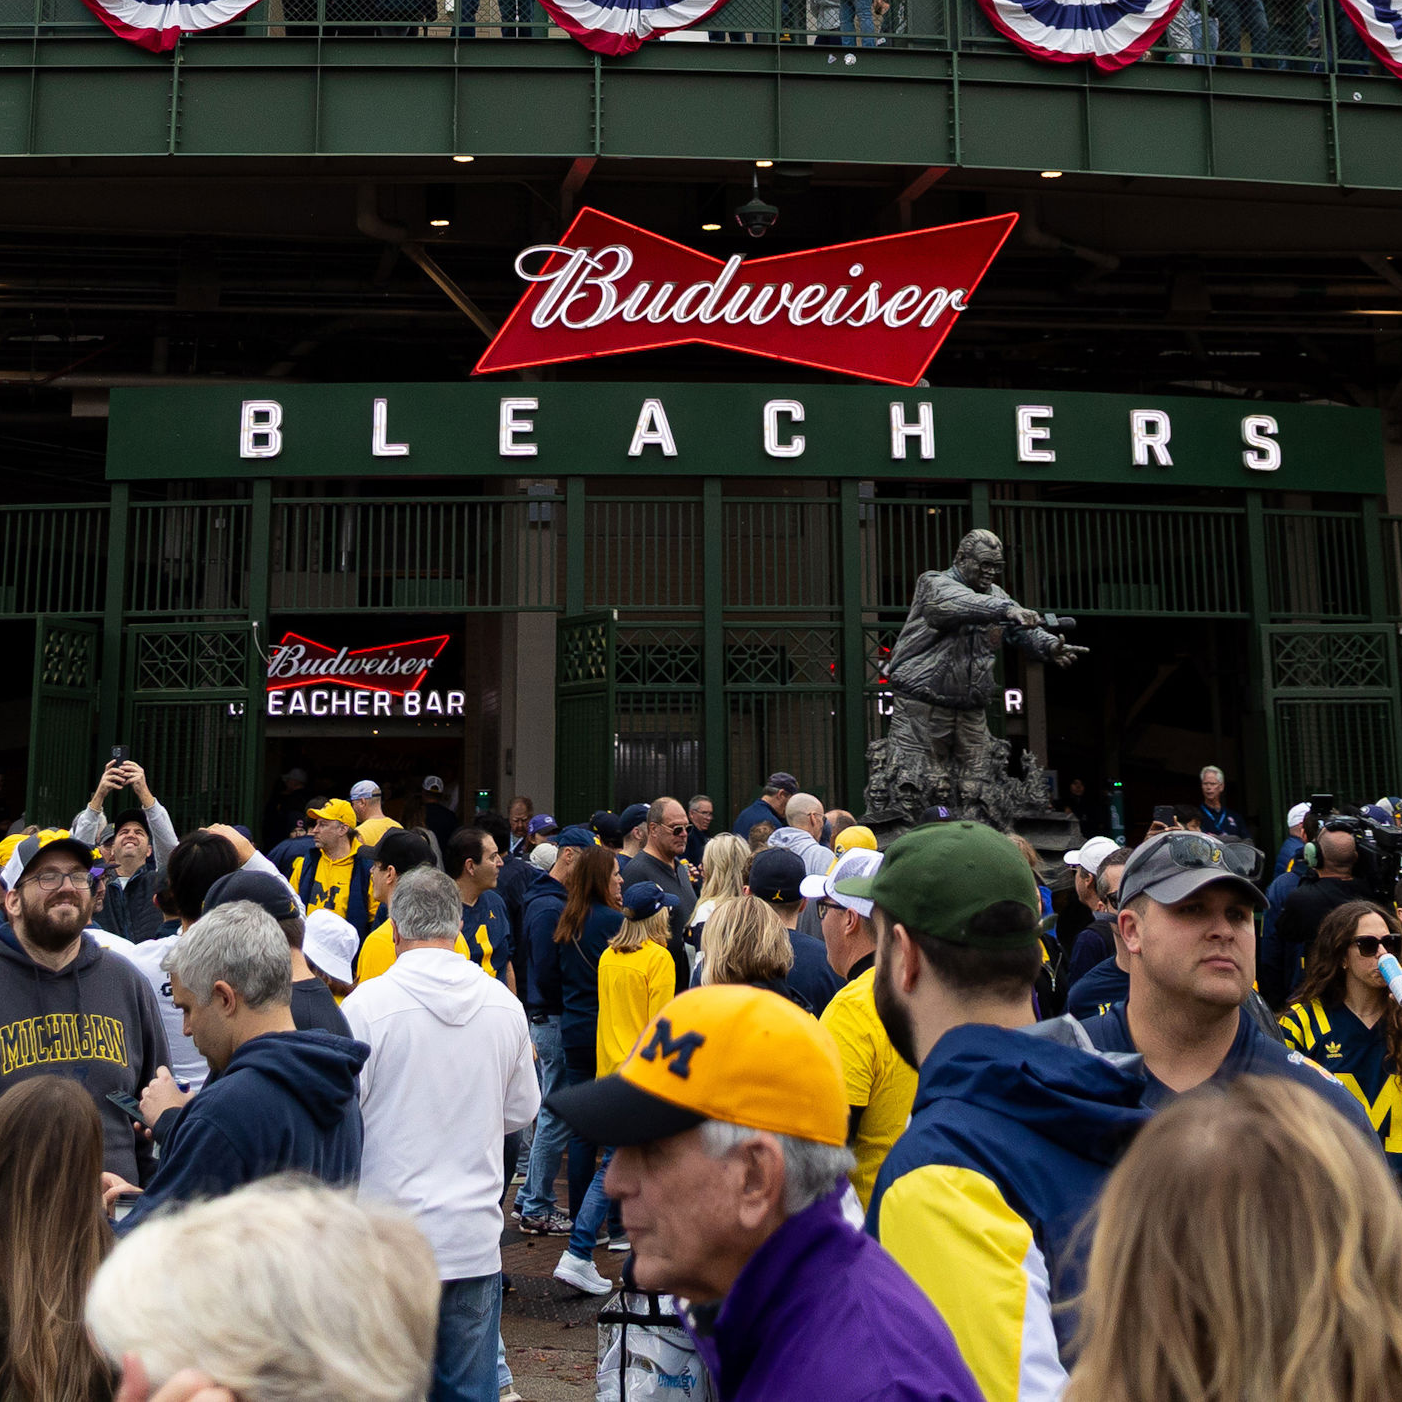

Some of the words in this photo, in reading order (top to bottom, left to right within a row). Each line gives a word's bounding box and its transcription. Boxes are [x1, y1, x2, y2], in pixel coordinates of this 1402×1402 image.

[514, 243, 969, 331] Budweiser
[239, 397, 1284, 472] BLEACHERS
[267, 644, 435, 679] Budweiser
[403, 689, 466, 717] BAR
[309, 880, 341, 910] M
[0, 1013, 129, 1076] MICHIGAN
[640, 1018, 705, 1080] M
